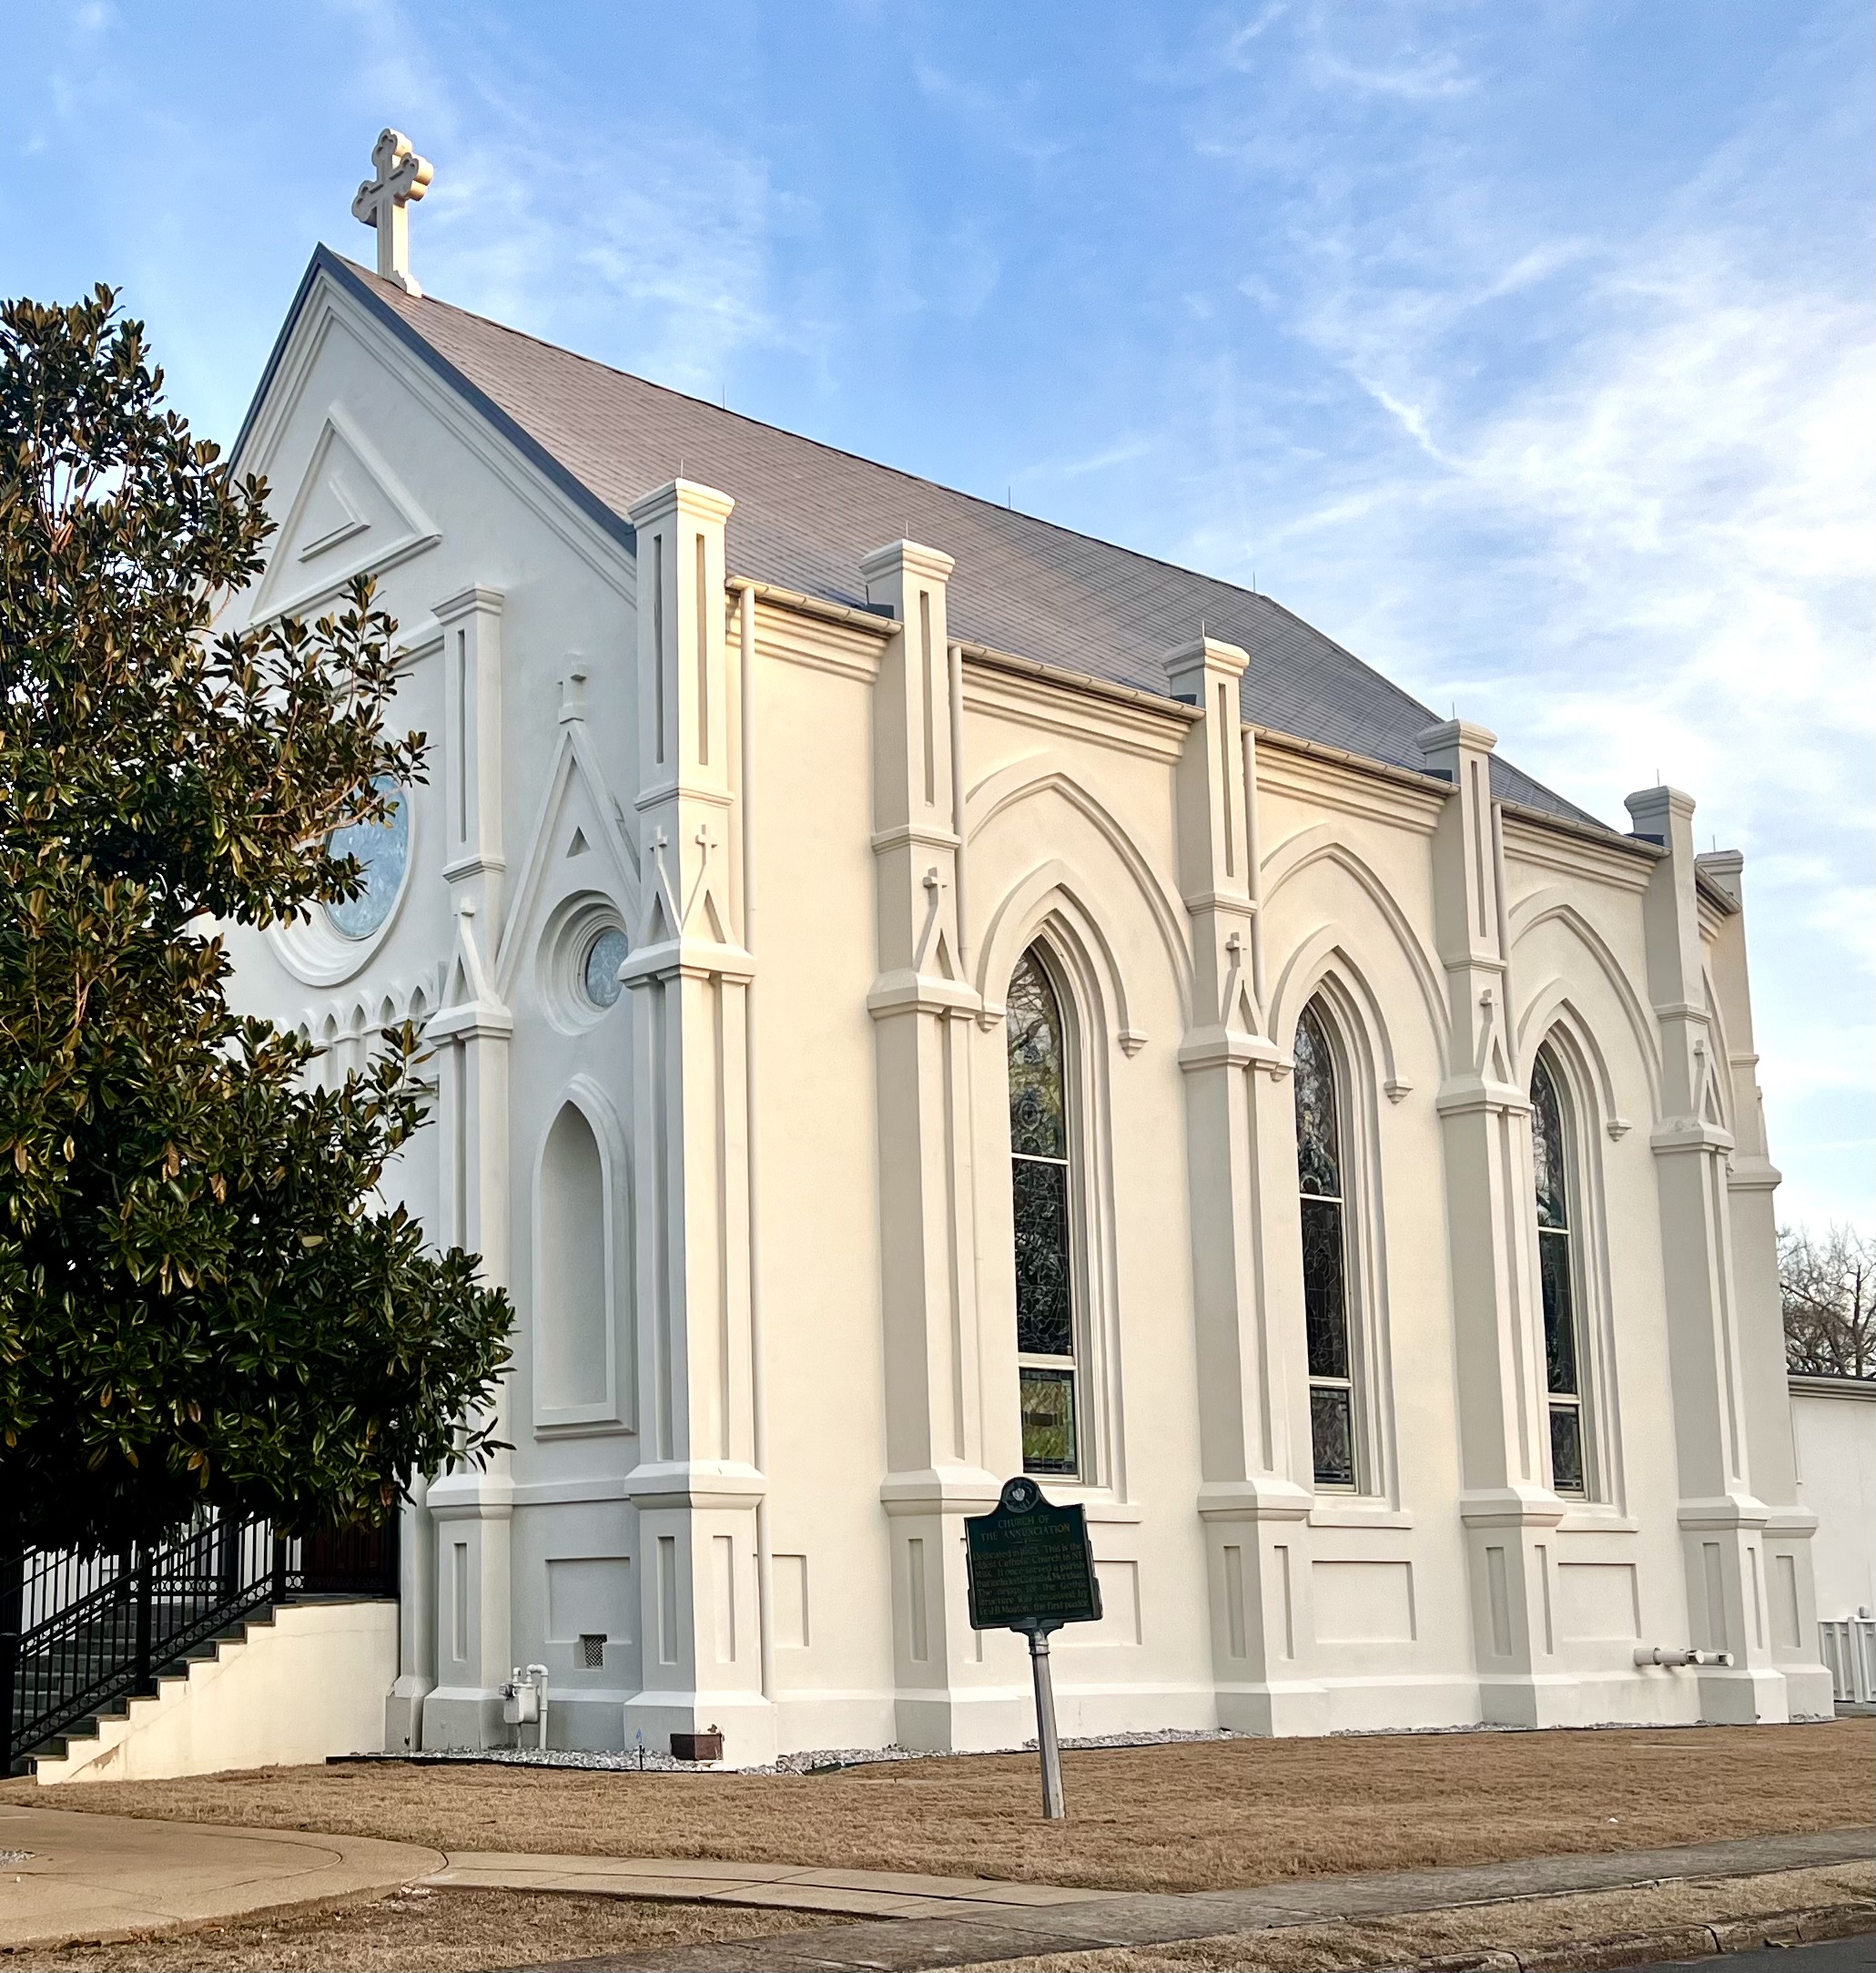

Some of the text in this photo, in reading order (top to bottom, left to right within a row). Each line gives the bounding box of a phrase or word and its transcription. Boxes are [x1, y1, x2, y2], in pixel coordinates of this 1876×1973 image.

[998, 1514, 1050, 1529] CHURCH OF
[980, 1522, 1070, 1542] THE ANNUNCIATION
[1043, 1544, 1060, 1553] This
[1061, 1543, 1069, 1551] is
[1070, 1541, 1083, 1551] the
[1032, 1552, 1061, 1564] Church
[1062, 1552, 1071, 1561] in
[1071, 1551, 1083, 1561] NE
[1060, 1561, 1085, 1572] parish
[977, 1588, 993, 1598] The
[1060, 1581, 1087, 1591] Gothic
[1077, 1589, 1088, 1600] by
